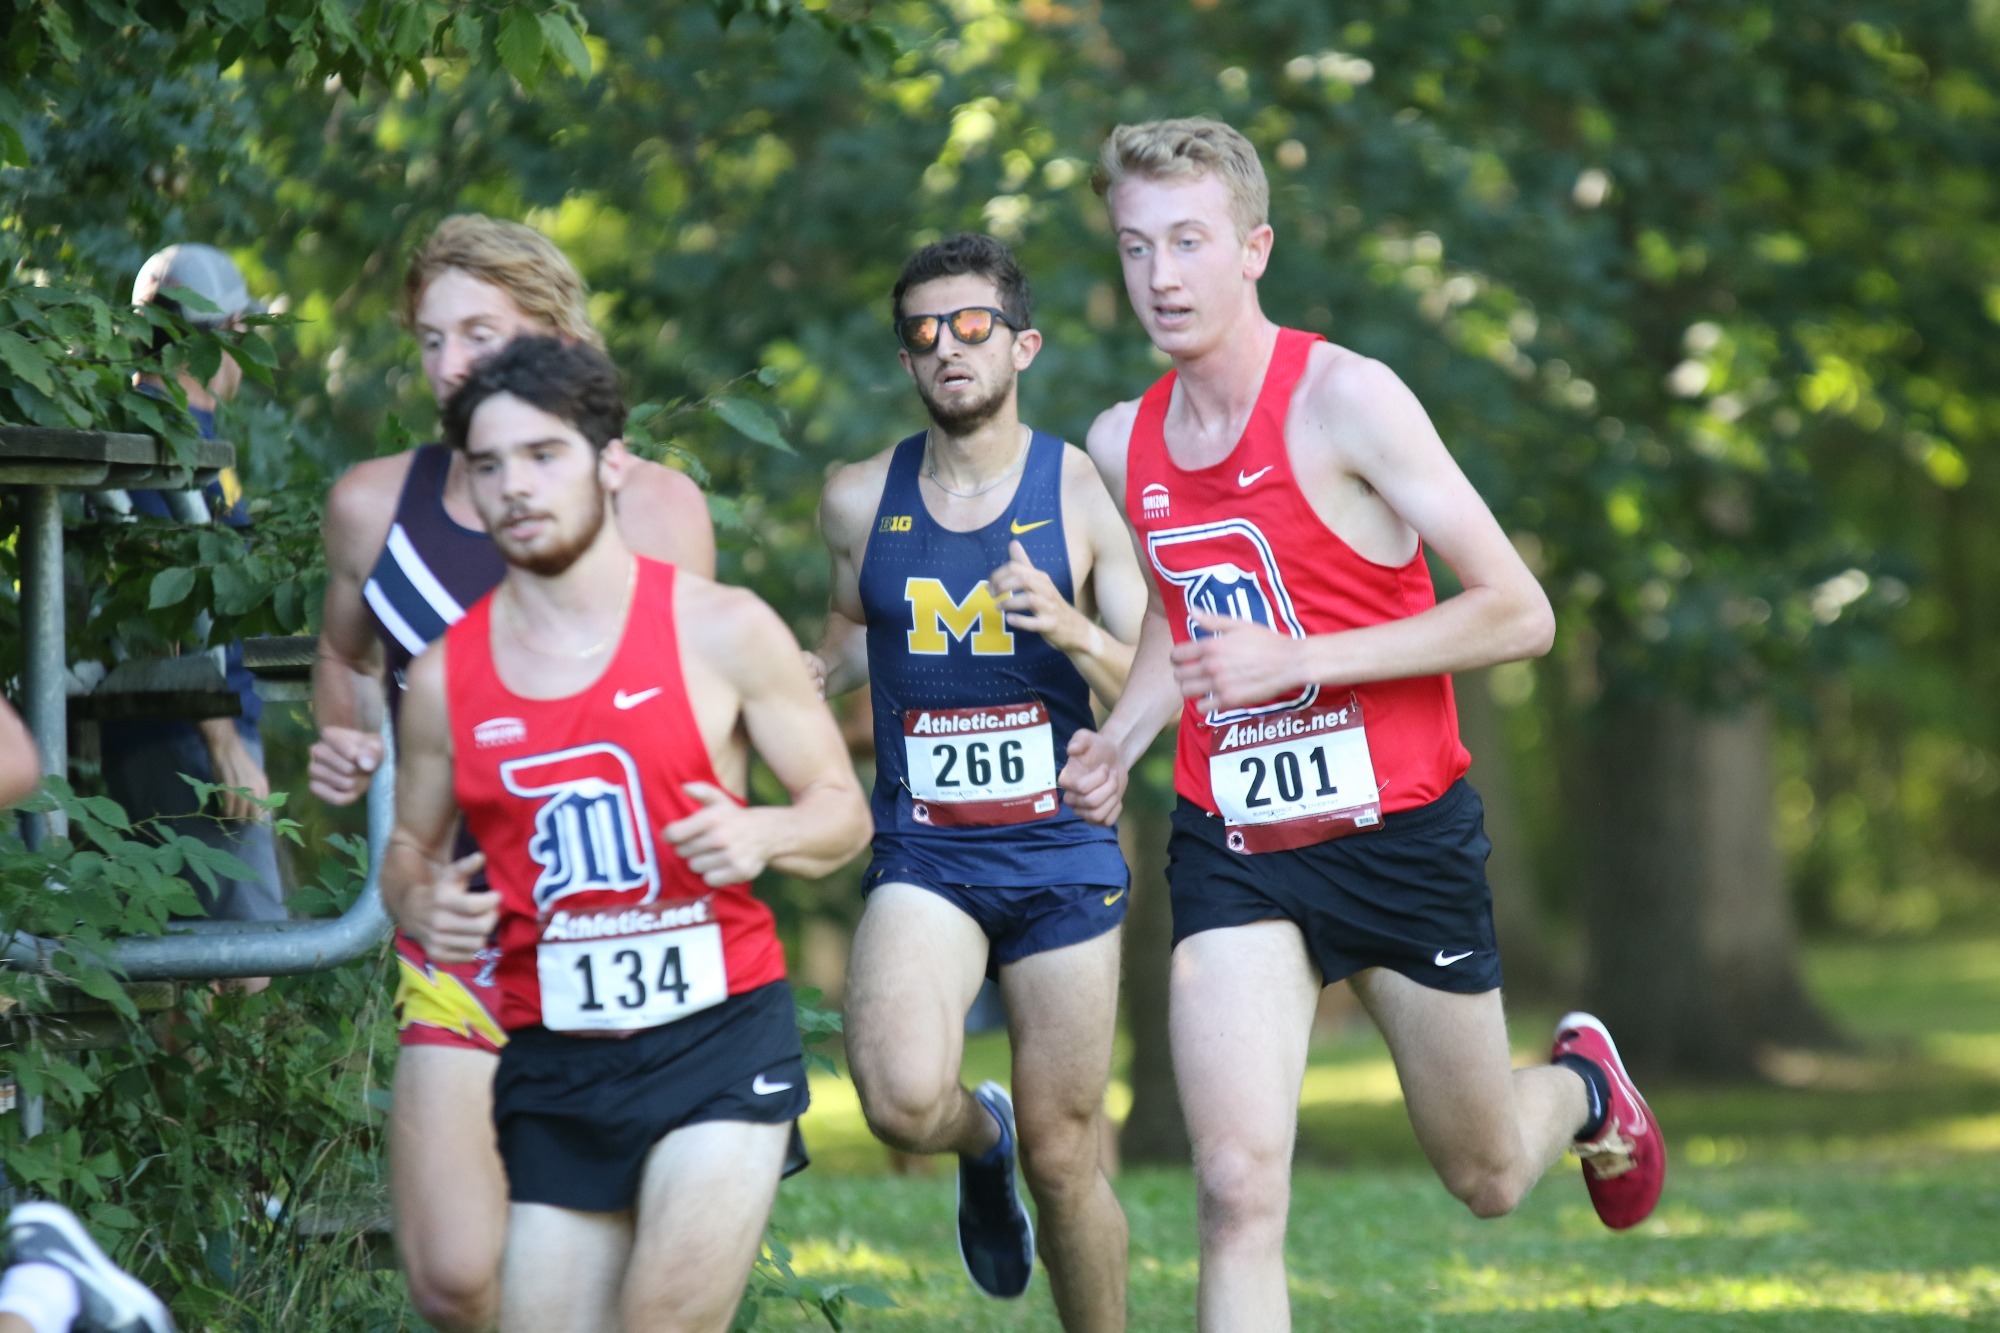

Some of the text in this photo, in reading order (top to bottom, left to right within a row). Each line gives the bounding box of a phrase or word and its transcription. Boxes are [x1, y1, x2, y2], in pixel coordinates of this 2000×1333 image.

[1142, 494, 1170, 511] IZON
[904, 577, 1015, 655] M
[912, 705, 1040, 734] Athletic.net
[1219, 707, 1349, 751] Athletic.net
[932, 740, 1025, 788] 266
[1240, 746, 1338, 809] 201
[541, 901, 708, 941] Athletic.net
[573, 946, 690, 1012] 134
